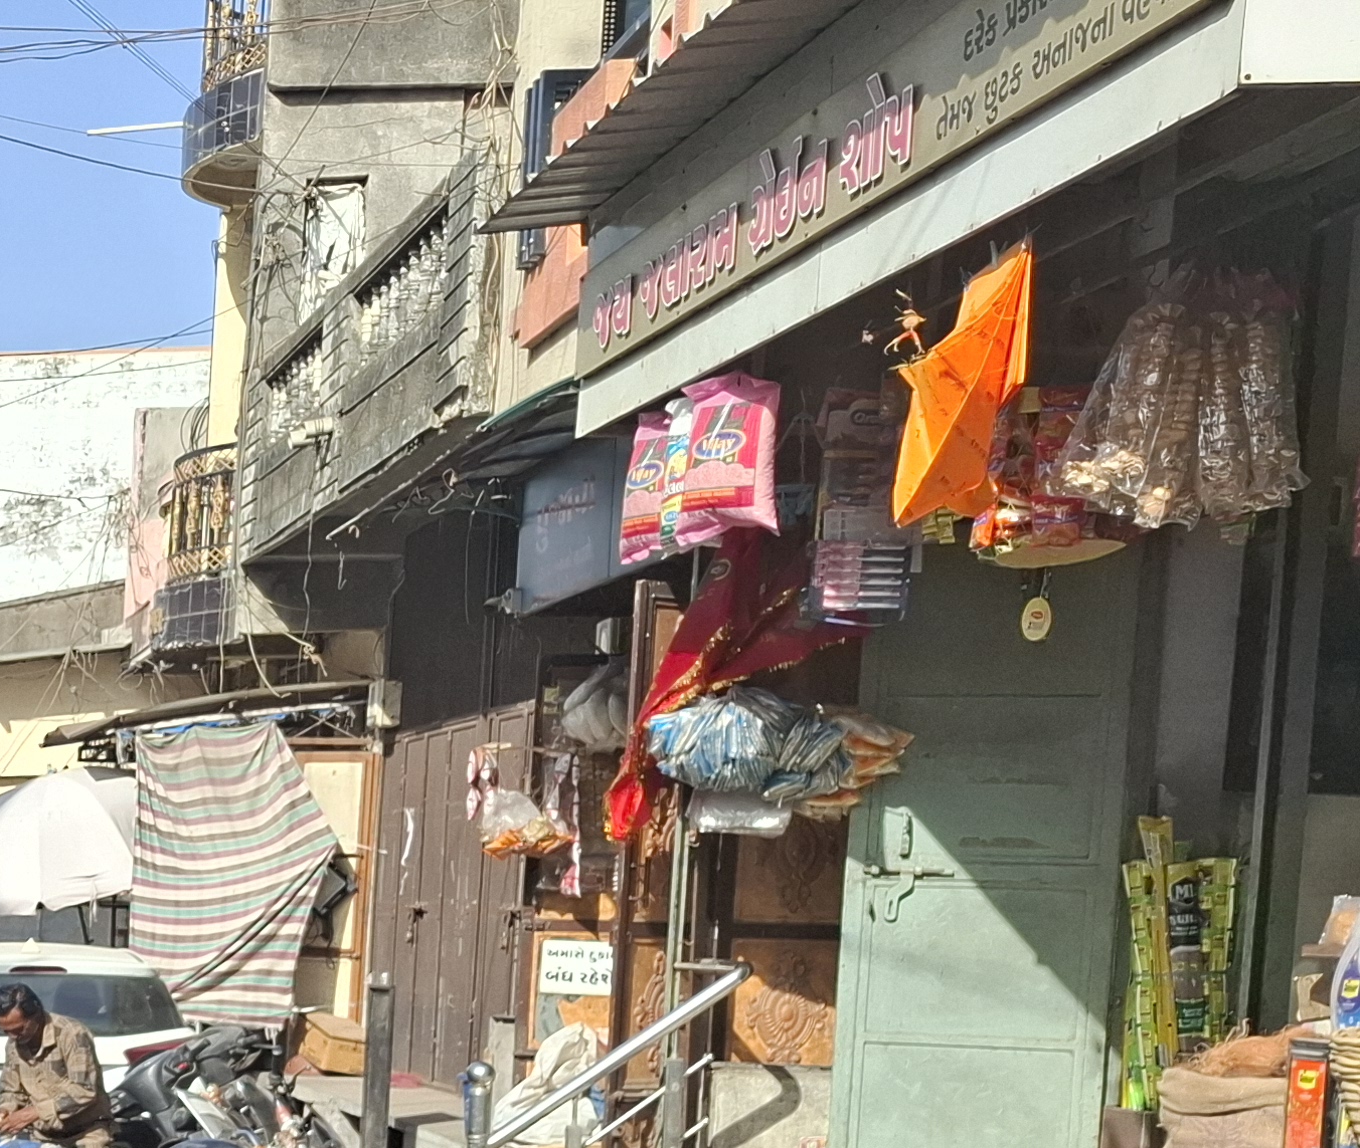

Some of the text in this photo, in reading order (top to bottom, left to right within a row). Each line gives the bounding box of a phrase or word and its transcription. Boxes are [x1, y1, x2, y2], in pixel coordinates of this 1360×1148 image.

[936, 95, 977, 140] તેમજ
[983, 61, 1024, 125] છુટક
[1031, 2, 1115, 80] અનાજના
[963, 9, 998, 61] દરેક
[593, 274, 633, 349] જય
[640, 202, 739, 320] જલારામ
[839, 72, 914, 196] શોપ
[545, 966, 574, 983] બંધ
